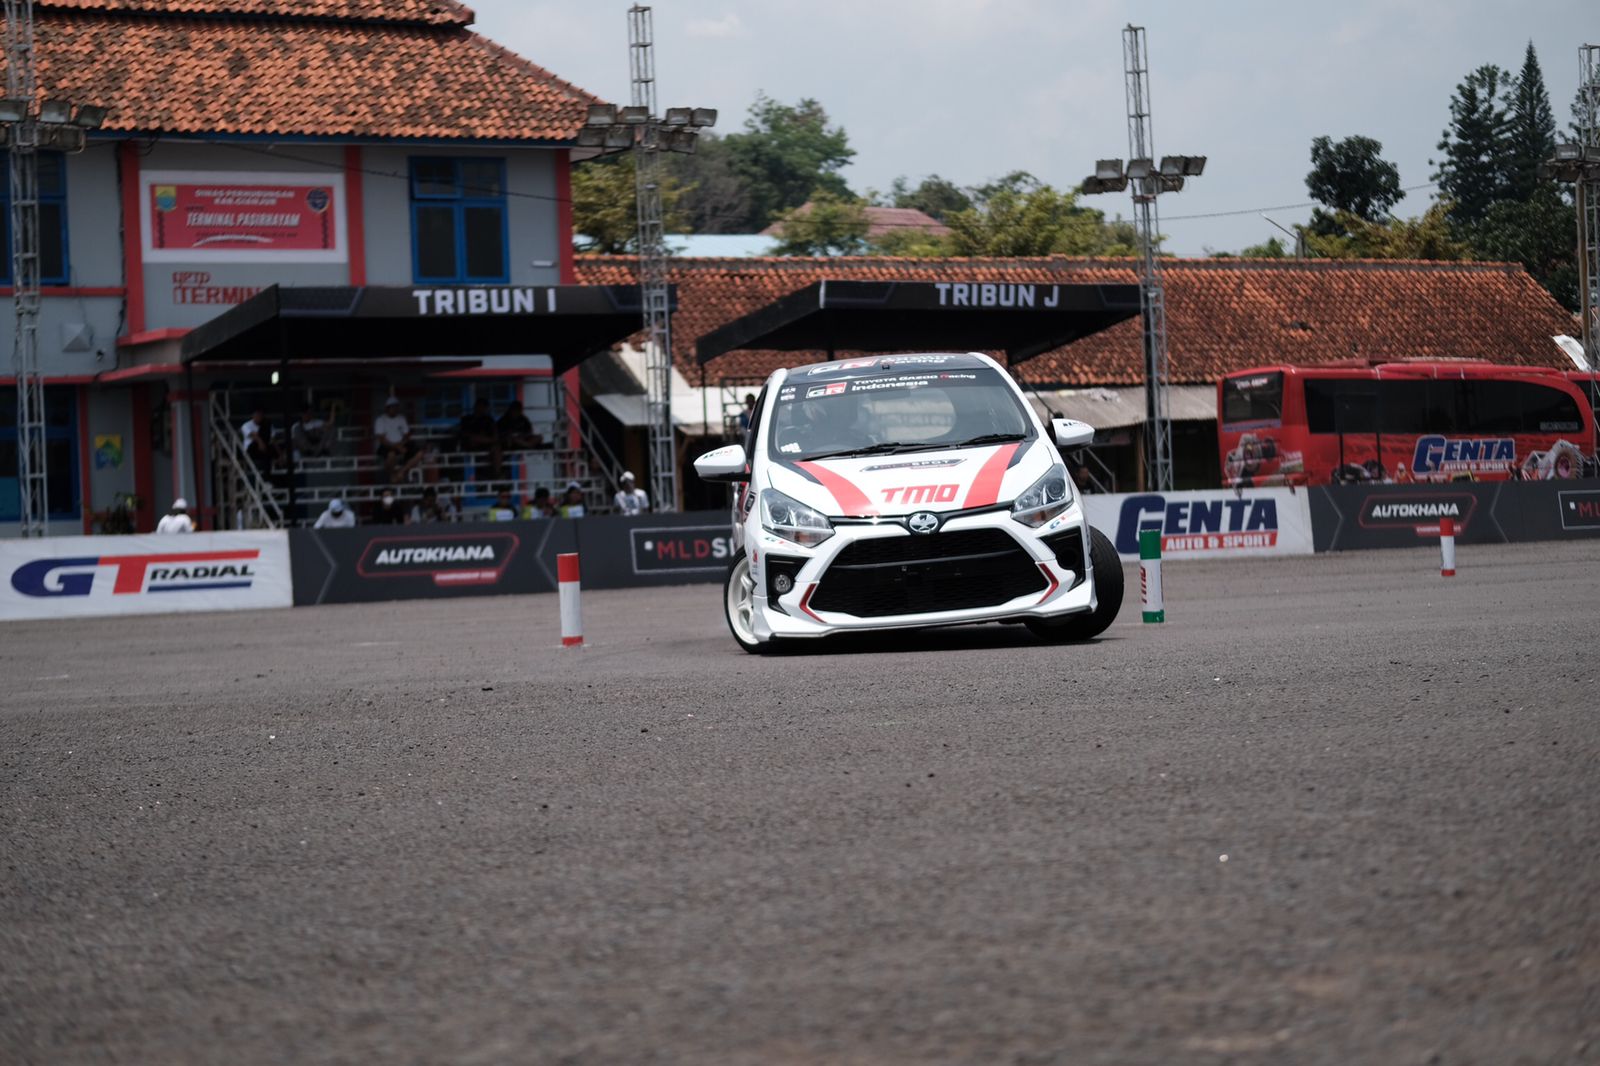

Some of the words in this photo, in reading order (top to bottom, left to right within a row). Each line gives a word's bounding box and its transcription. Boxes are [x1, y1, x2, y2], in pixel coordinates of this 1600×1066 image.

[187, 212, 234, 227] TERMINAL
[413, 289, 534, 314] TRIBUN
[547, 288, 557, 312] I
[935, 283, 1035, 307] TRIBUN
[1044, 285, 1059, 307] J
[808, 384, 846, 397] GR
[852, 381, 929, 391] Indonesia
[853, 377, 897, 385] TOYOTA
[1413, 435, 1515, 474] GENTA
[881, 484, 960, 505] TMO
[1372, 503, 1459, 518] AUTOKHANA
[1115, 494, 1278, 554] GENTA
[1166, 536, 1205, 551] AUTO
[1223, 533, 1272, 548] SPORT
[375, 545, 494, 565] AUTOKHANA
[11, 549, 260, 598] GT
[150, 562, 255, 581] RADIAL
